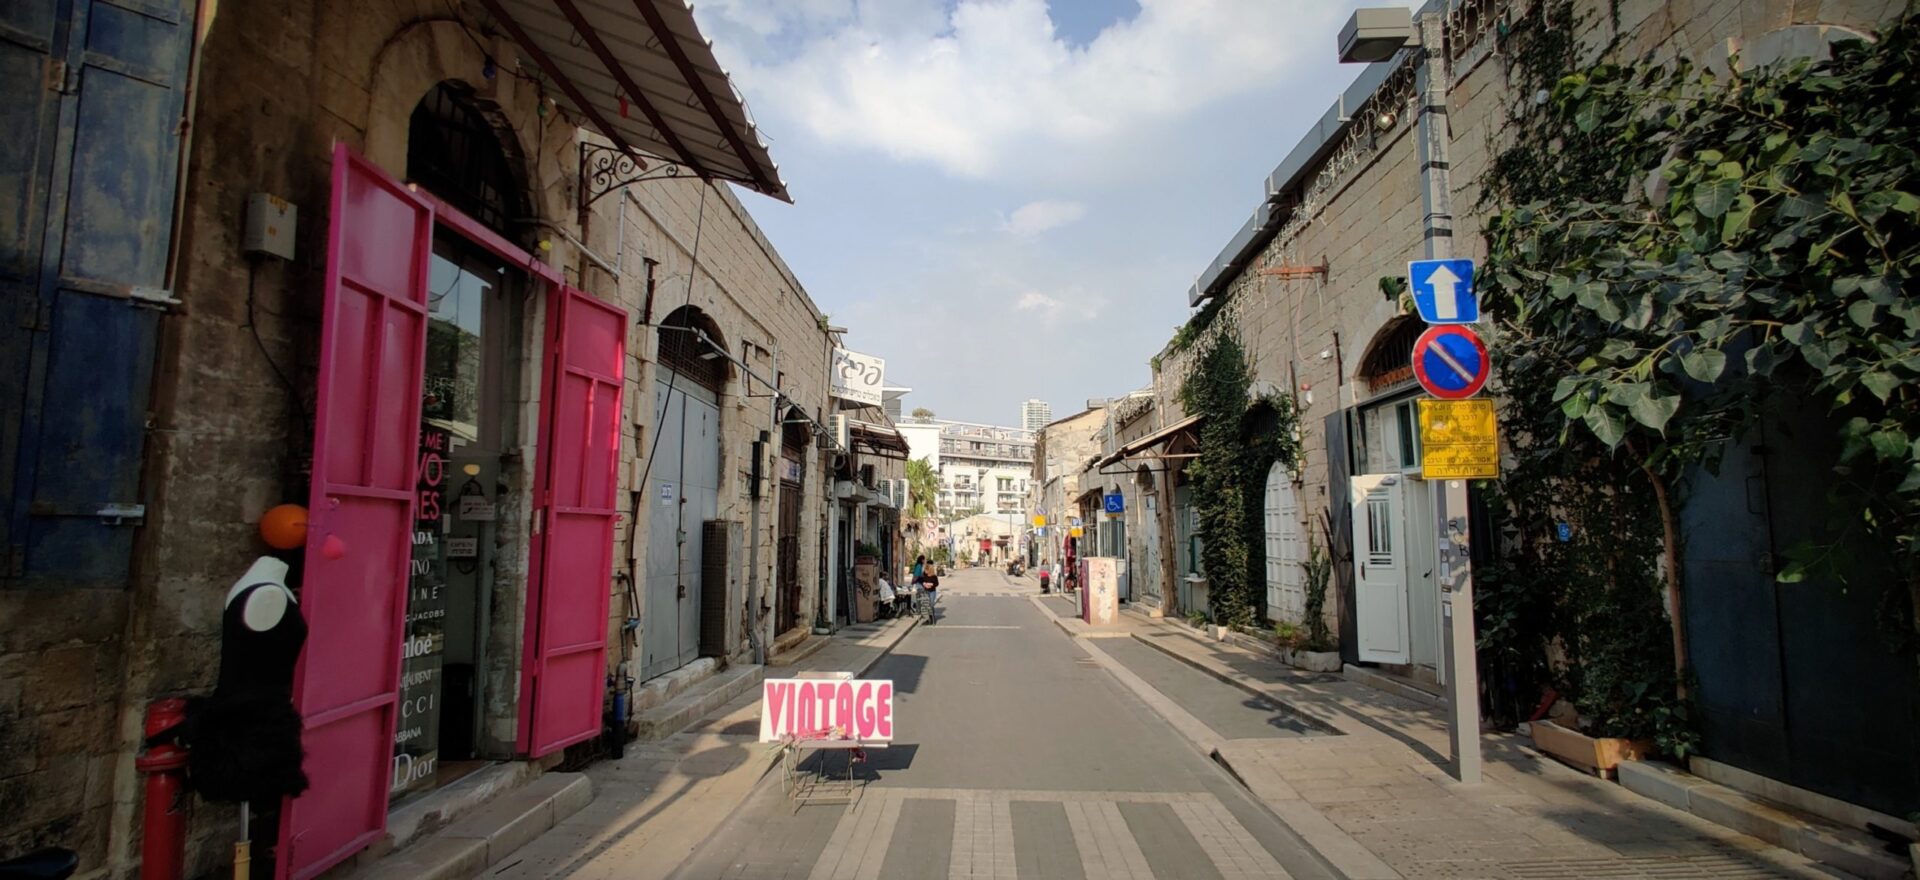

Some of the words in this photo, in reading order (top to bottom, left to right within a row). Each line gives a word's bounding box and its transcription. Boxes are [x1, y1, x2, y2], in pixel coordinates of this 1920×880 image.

[426, 433, 442, 449] ME
[413, 609, 445, 621] JACOBS
[402, 694, 434, 718] CCI
[766, 682, 891, 738] VINTAGE
[391, 753, 436, 793] Dior
